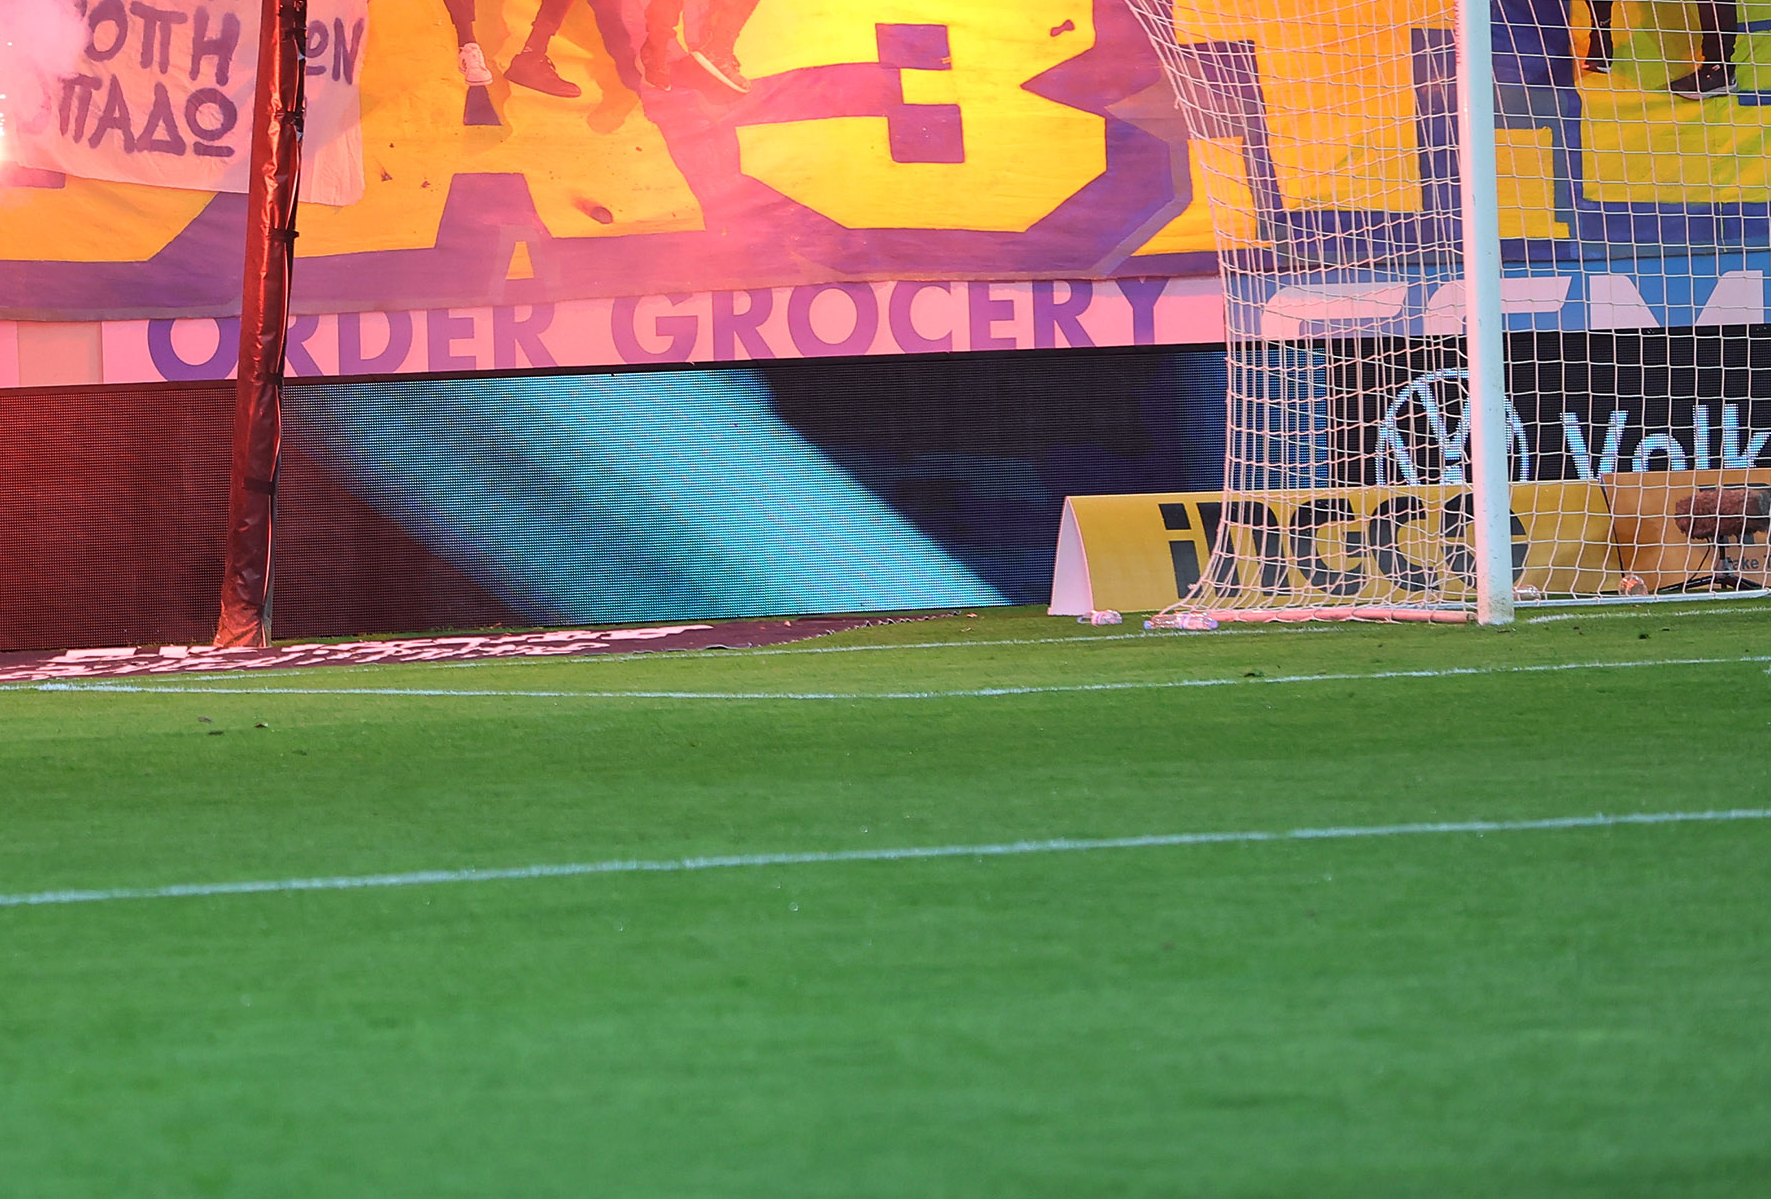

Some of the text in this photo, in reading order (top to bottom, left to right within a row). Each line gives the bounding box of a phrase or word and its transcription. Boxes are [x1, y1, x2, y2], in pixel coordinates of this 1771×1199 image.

[304, 17, 366, 85] ΩΝ
[56, 74, 238, 157] ΠΑΔΩ
[611, 277, 1171, 366] GROCERY
